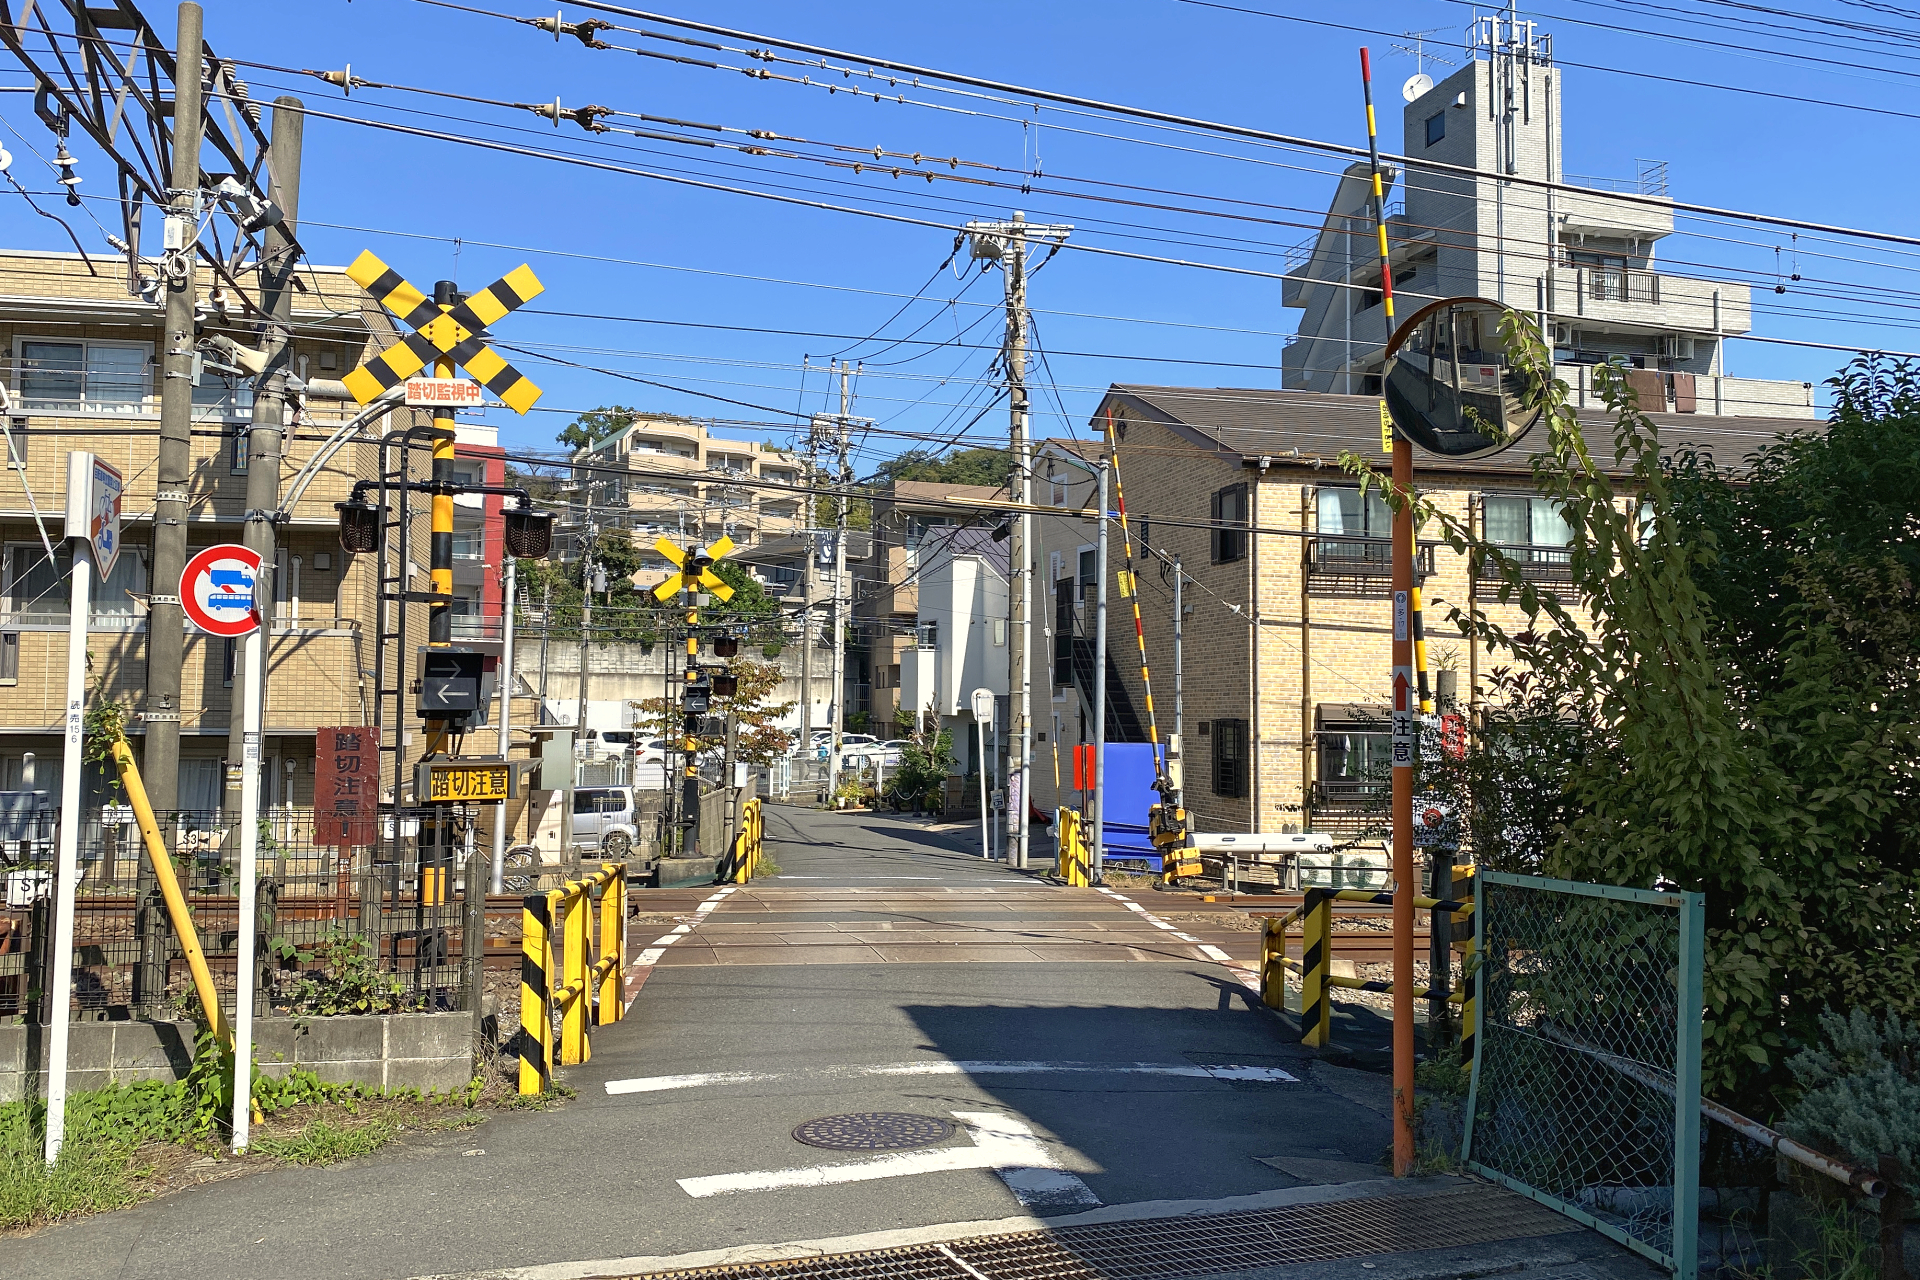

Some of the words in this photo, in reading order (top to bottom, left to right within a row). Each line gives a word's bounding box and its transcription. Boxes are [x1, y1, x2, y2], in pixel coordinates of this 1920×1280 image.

[407, 382, 480, 402] 踏切監視中
[1393, 716, 1411, 762] 注意
[432, 769, 507, 798] 踏切注意
[182, 833, 197, 845] S3
